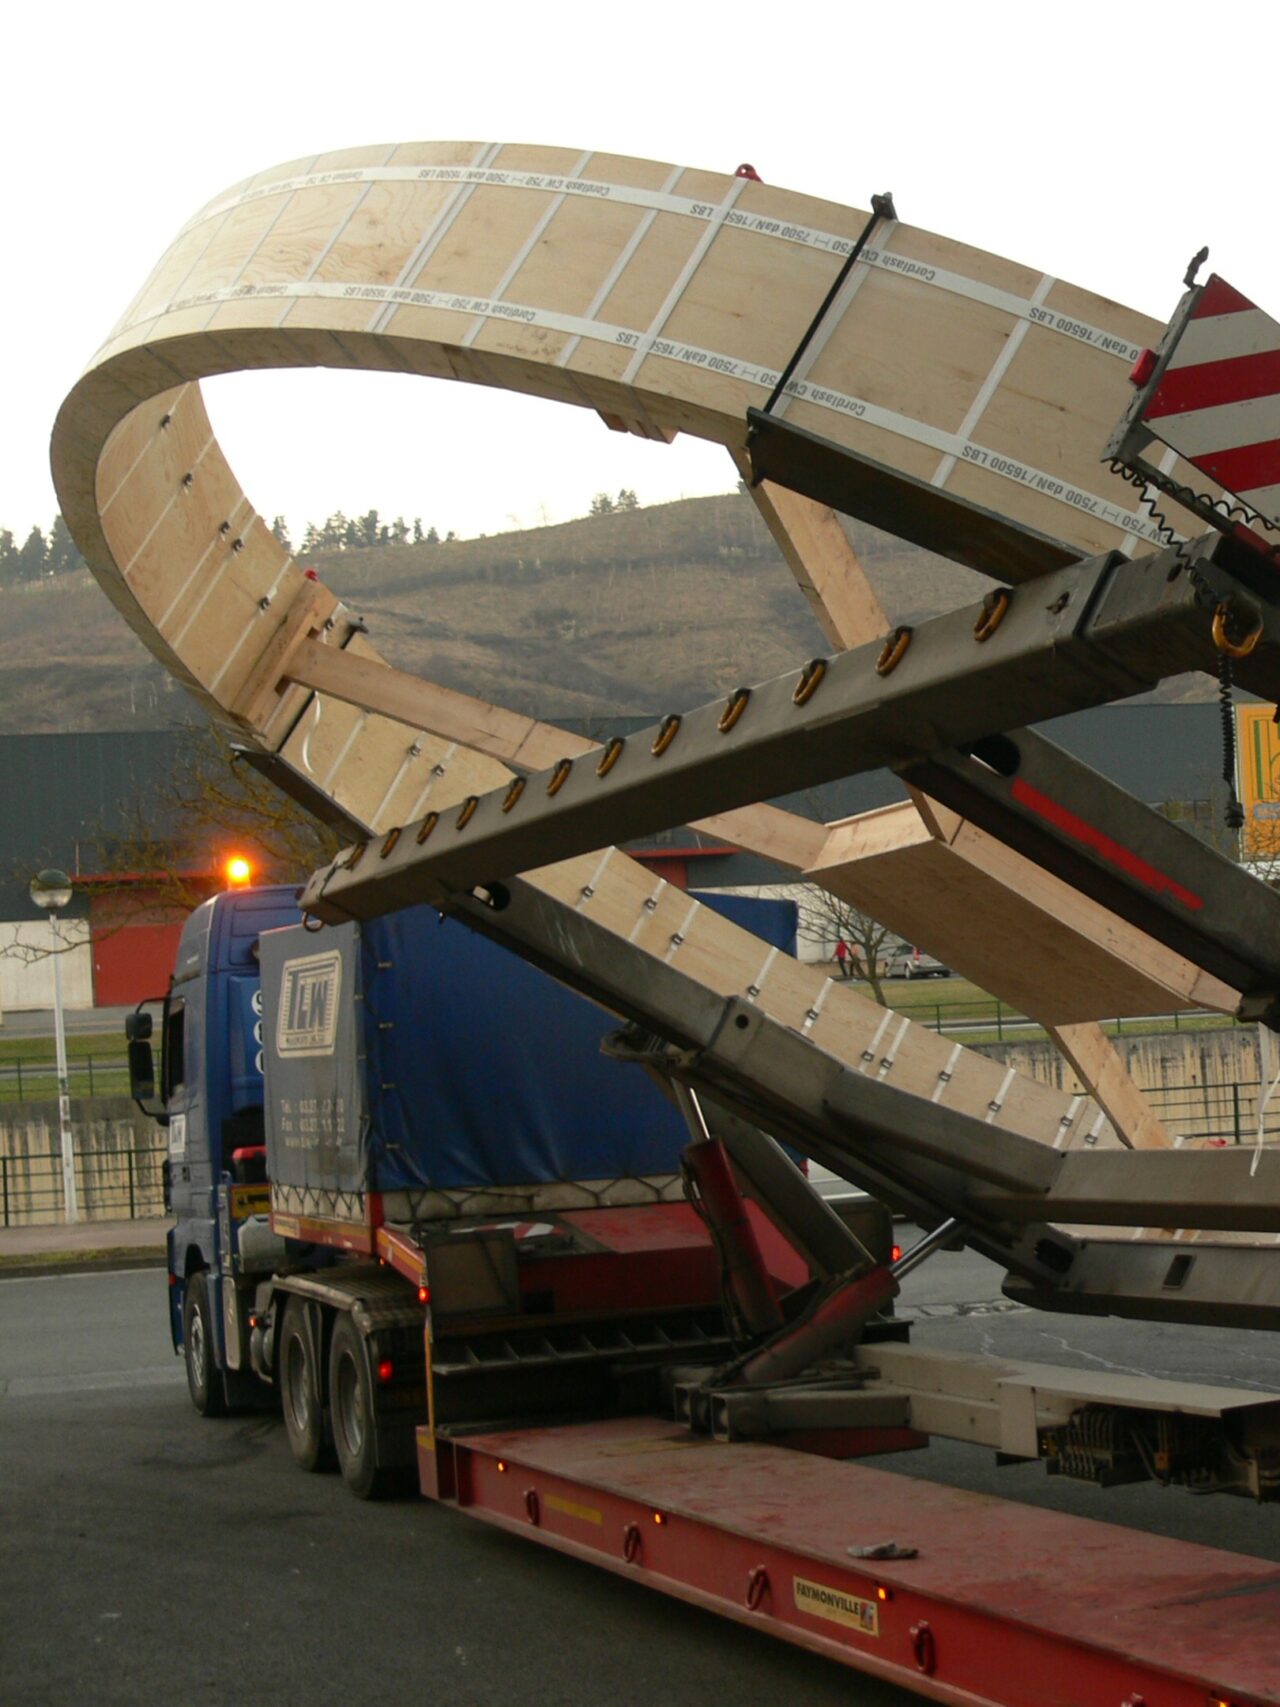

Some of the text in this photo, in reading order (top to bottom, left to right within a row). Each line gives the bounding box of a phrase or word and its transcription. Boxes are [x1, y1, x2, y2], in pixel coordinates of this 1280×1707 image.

[689, 203, 714, 218] LBS
[781, 226, 811, 243] 7500
[882, 255, 936, 281] Cordlash
[1029, 306, 1055, 325] LBS
[615, 331, 640, 346] LBS
[708, 357, 739, 375] 7500
[785, 380, 808, 396] CW
[811, 388, 866, 416] Cordlash
[962, 445, 988, 464] LBS
[1065, 489, 1098, 513] 7500
[1121, 515, 1147, 535] 750
[796, 1583, 860, 1614] FAYMONVILLE
